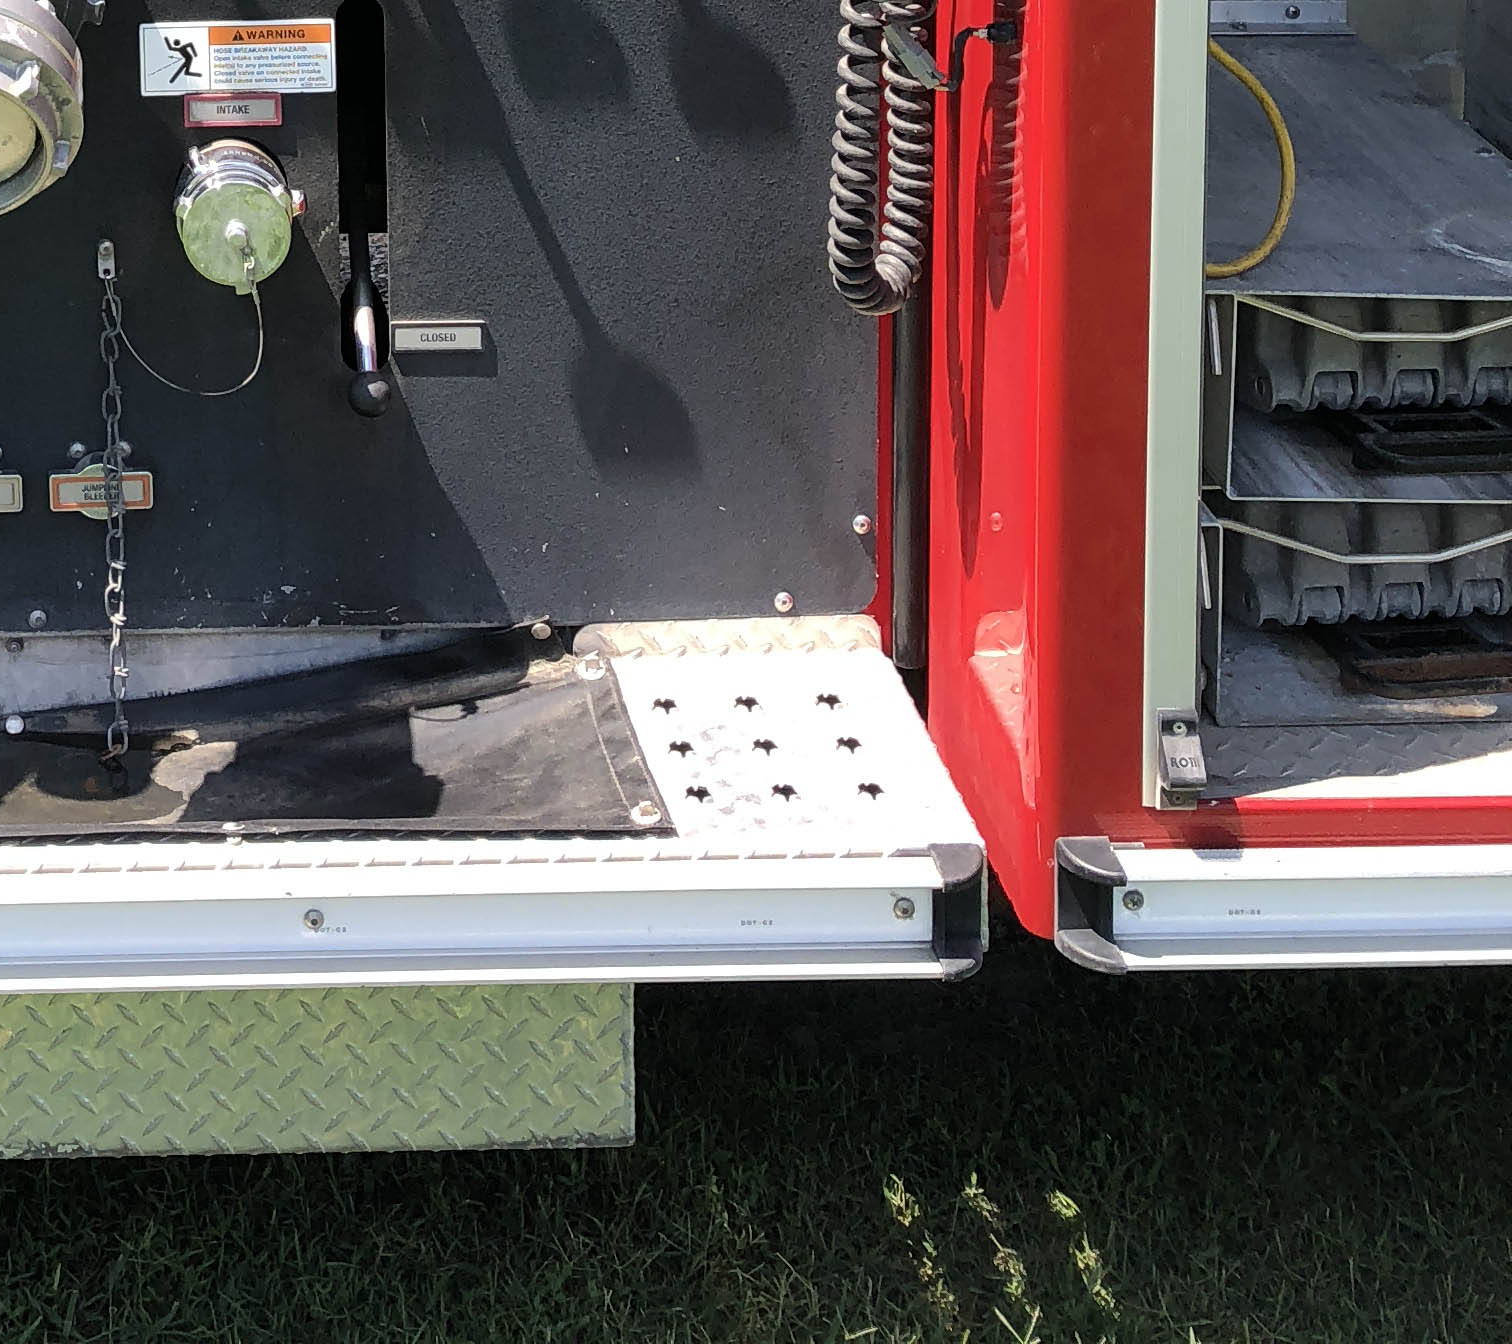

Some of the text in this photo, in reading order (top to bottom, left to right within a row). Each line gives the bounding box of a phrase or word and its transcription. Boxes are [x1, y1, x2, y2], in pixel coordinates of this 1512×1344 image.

[246, 29, 306, 40] WARNING
[216, 105, 250, 115] INTAKE
[420, 333, 456, 342] CLOSED
